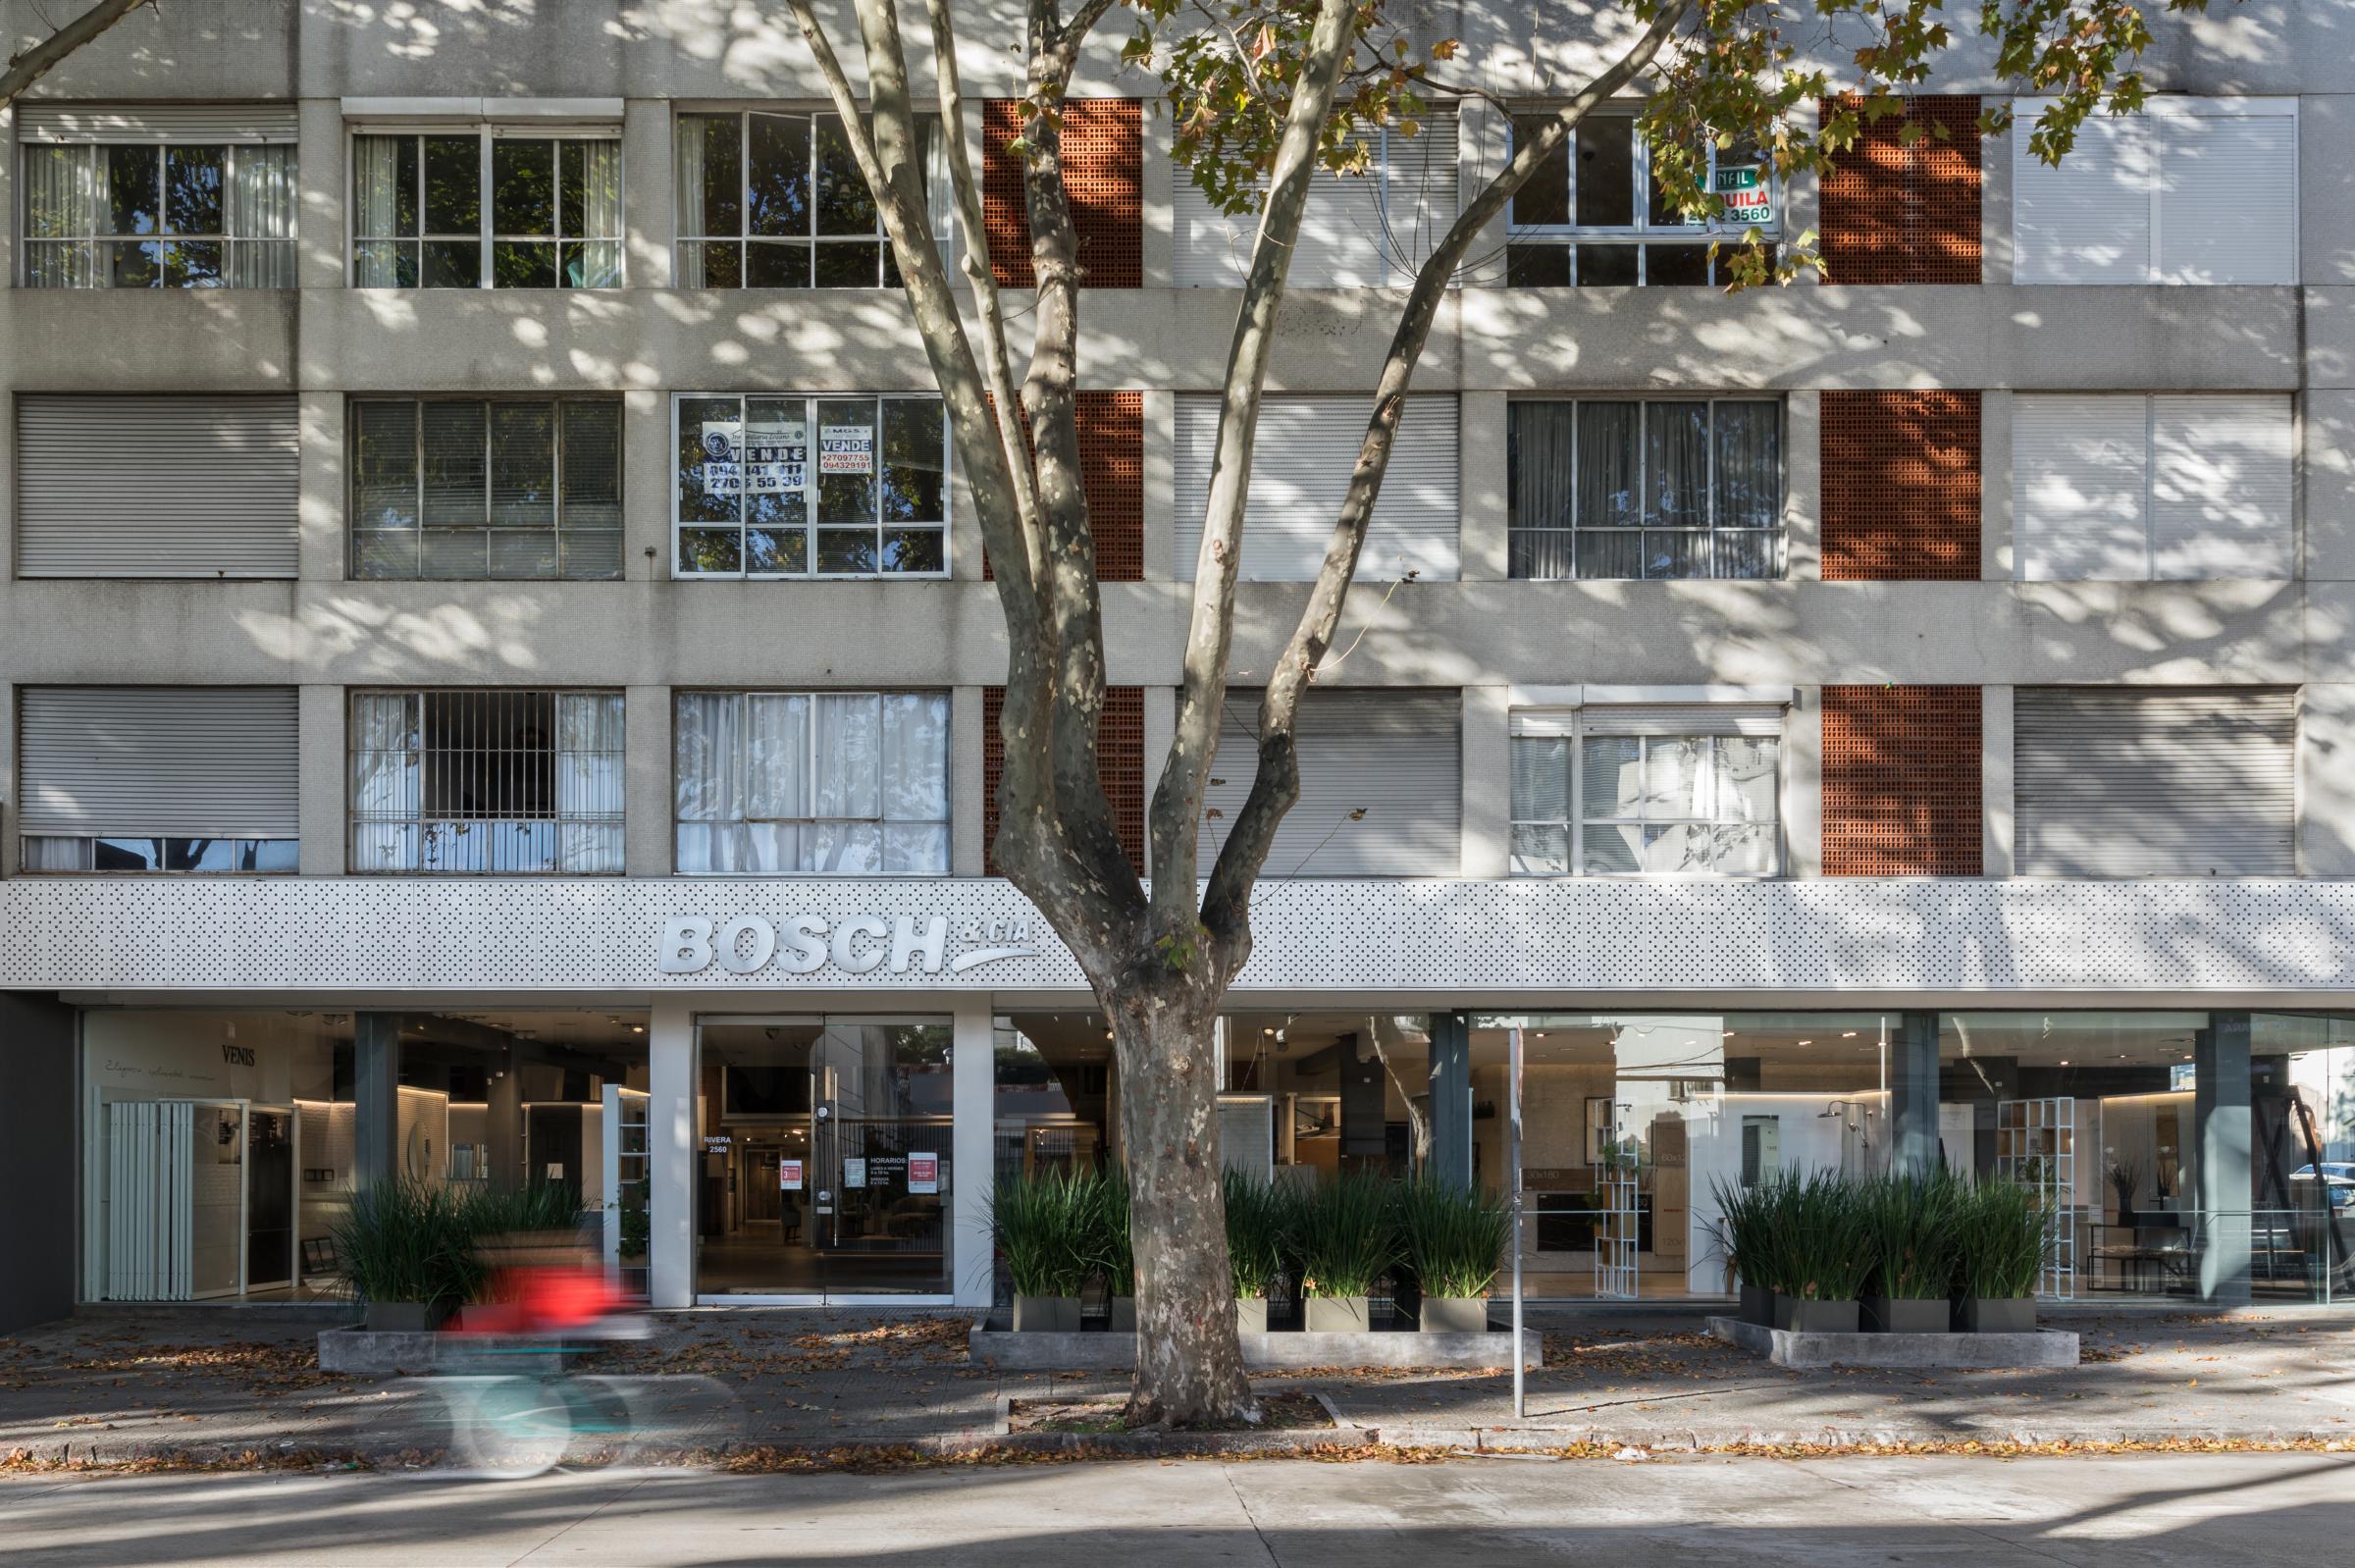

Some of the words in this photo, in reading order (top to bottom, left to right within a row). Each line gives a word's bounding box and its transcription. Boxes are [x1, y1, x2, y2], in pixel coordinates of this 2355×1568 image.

[1730, 207, 1770, 222] 3560
[822, 440, 870, 451] VENDE
[730, 447, 804, 461] VENDE
[757, 477, 776, 489] 55
[659, 915, 948, 974] BOSCH
[958, 918, 981, 943] &
[988, 918, 1030, 943] CIA
[222, 1045, 255, 1067] VENIS
